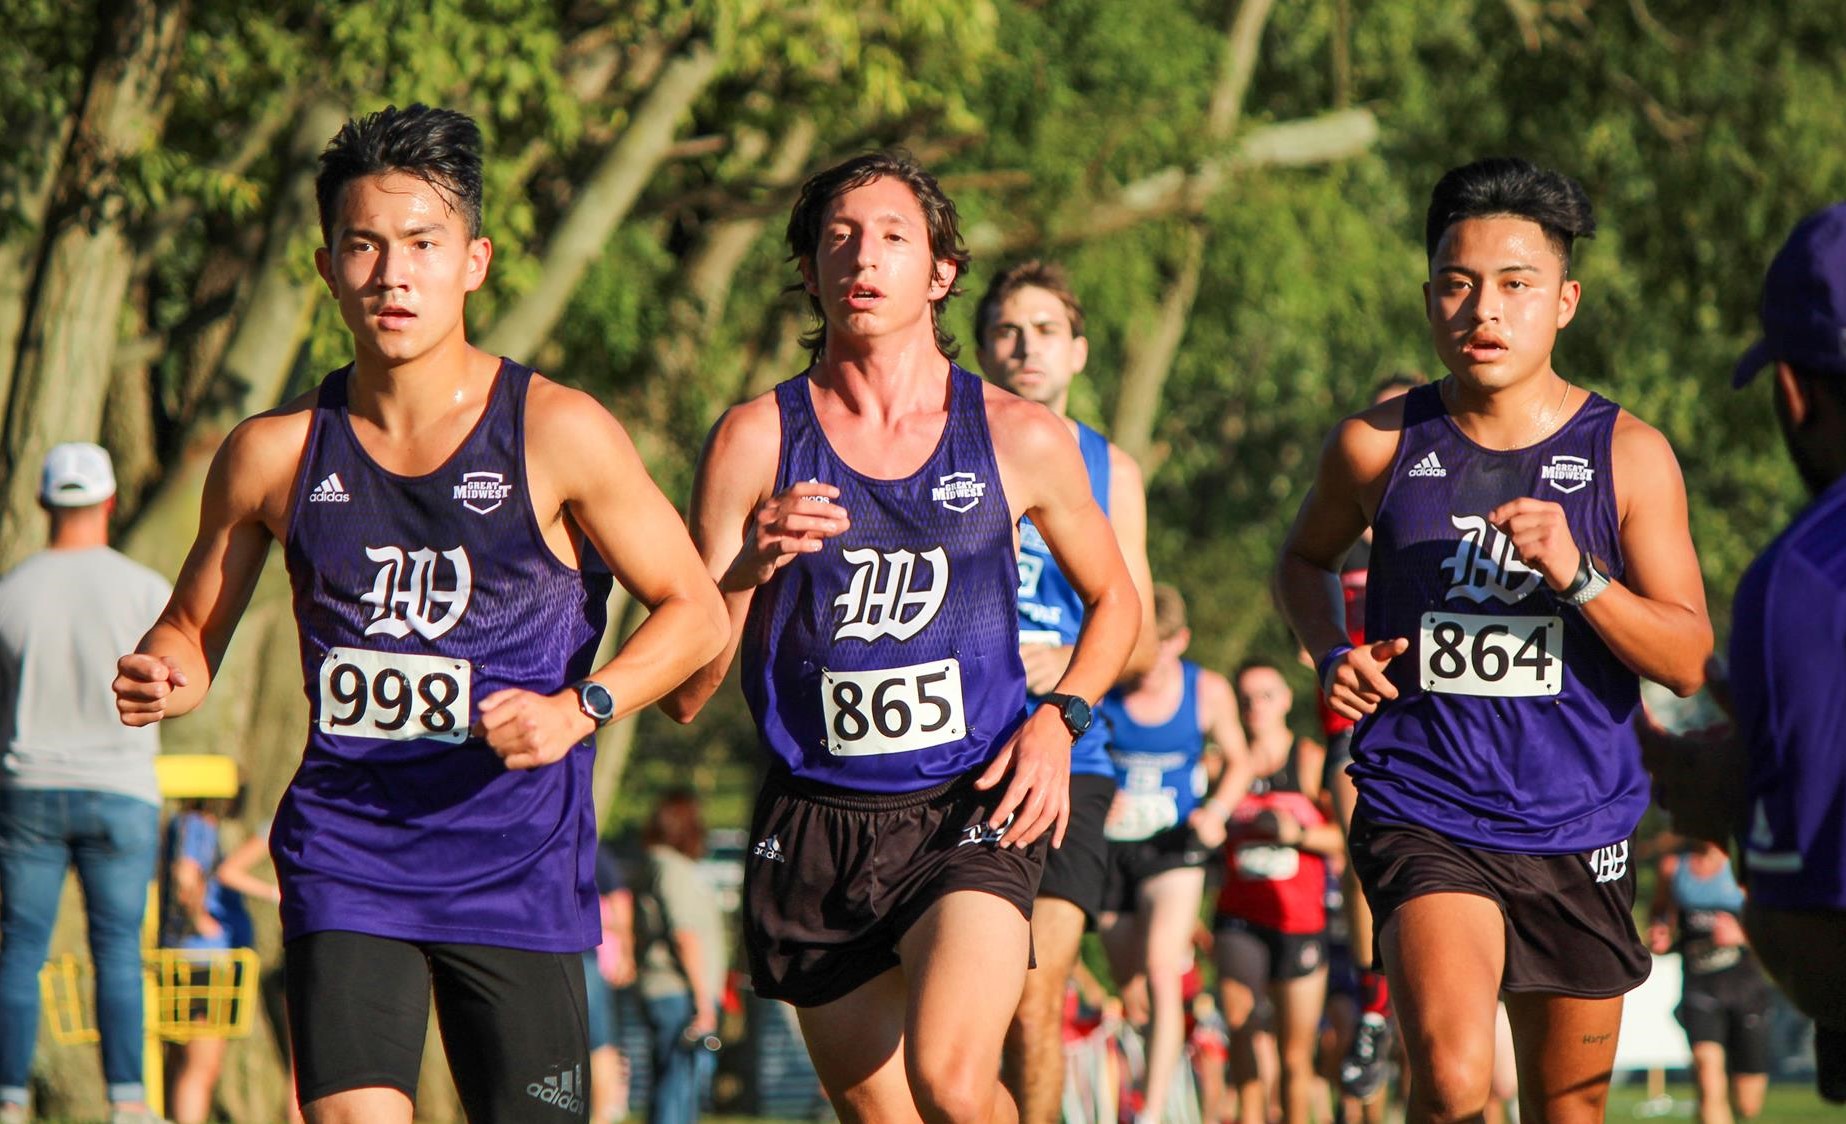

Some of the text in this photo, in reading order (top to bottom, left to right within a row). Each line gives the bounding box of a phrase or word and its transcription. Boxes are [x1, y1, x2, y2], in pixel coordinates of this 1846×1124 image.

[1408, 467, 1447, 477] adidas
[1541, 465, 1595, 481] MIDWEST
[1555, 463, 1585, 472] GREAT
[453, 484, 512, 499] MIDWEST
[467, 481, 500, 490] GREAT
[932, 482, 986, 501] MIDWEST
[945, 480, 973, 491] GREAT
[309, 491, 350, 502] adidas
[1429, 621, 1553, 682] 864
[329, 663, 459, 732] 998
[832, 671, 952, 741] 865
